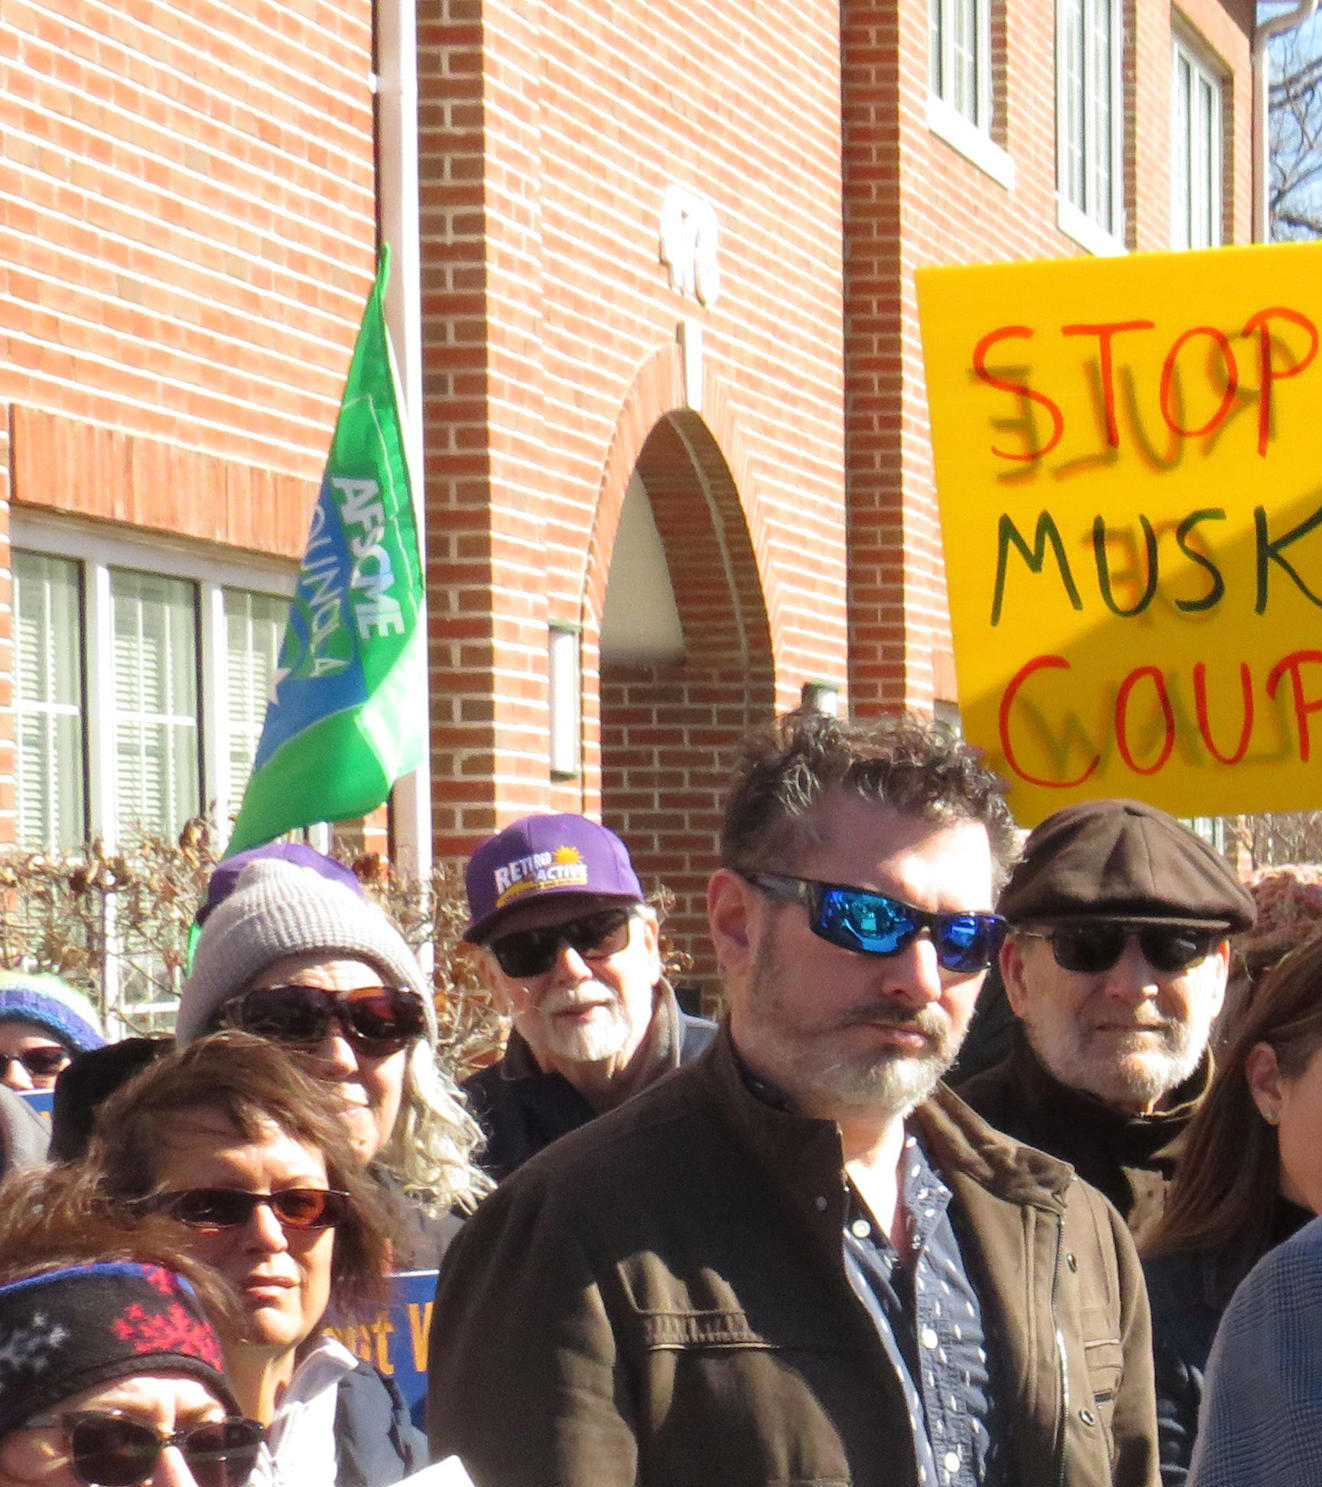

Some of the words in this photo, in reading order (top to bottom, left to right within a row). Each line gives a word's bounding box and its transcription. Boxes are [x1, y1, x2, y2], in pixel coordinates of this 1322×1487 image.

[972, 306, 1320, 462] STOP
[329, 476, 406, 640] AFSCME
[536, 863, 588, 882] ACTIVE
